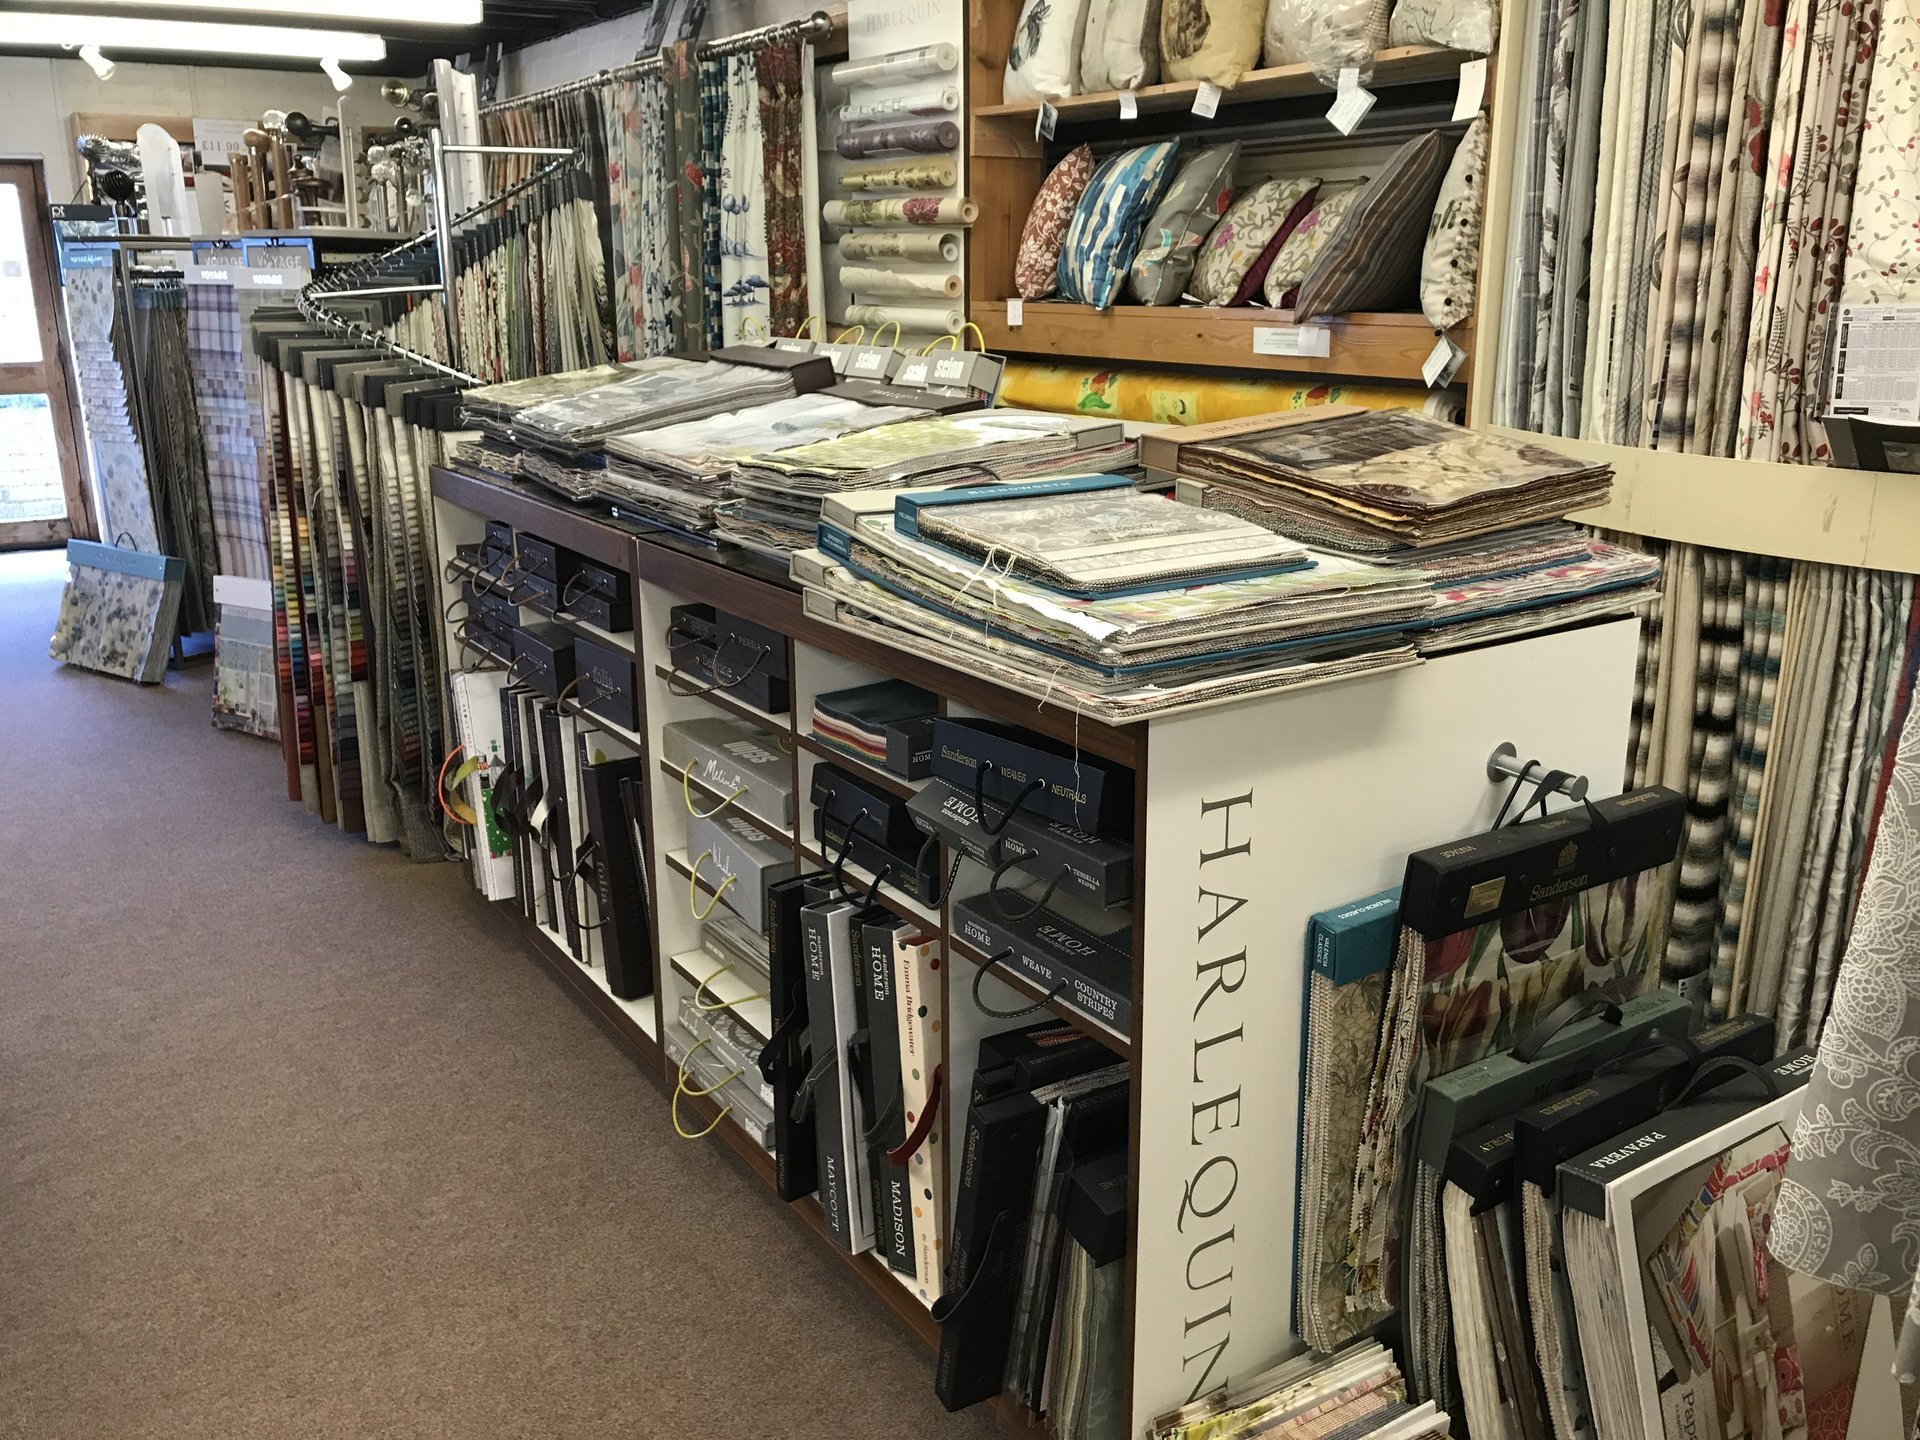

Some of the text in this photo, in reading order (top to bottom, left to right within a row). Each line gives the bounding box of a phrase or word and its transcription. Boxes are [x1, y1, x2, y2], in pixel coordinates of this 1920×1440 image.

[866, 1, 943, 32] HARLEQUIN
[202, 140, 240, 151] £11.99
[257, 256, 302, 267] VOYAGE
[855, 350, 882, 370] scion
[934, 357, 965, 379] scion
[738, 635, 762, 652] PERSIA
[912, 754, 931, 763] HOM
[941, 744, 1087, 804] Sanderson WEAVES NEUTRALS
[941, 808, 970, 825] sanderson
[1072, 868, 1100, 887] TESSELLA
[1077, 878, 1096, 891] WEAVES
[1530, 873, 1588, 901] Sanderson
[769, 898, 778, 953] Sanderson
[1038, 925, 1098, 957] HOME
[807, 927, 821, 982] HOME
[817, 935, 825, 976] sanderson
[851, 928, 862, 987] Sanderson
[964, 924, 1052, 980] HOME WEAVE
[1316, 933, 1324, 963] CLASSICS
[1322, 937, 1330, 967] VALENCIA
[871, 945, 885, 1001] HOME
[881, 954, 890, 995] sanderson
[903, 960, 916, 1057] Emma Bridgewater
[1074, 979, 1118, 1010] COUNTRY
[1076, 991, 1115, 1020] STRIPES
[1773, 1054, 1817, 1076] HOME
[1177, 787, 1253, 1405] HARLEQUIN
[1539, 1088, 1599, 1116] Sanderson
[964, 1124, 980, 1188] Sanderson
[1589, 1131, 1667, 1169] PAPAVERA
[827, 1155, 840, 1232] MAYCOTT
[891, 1180, 906, 1257] MADISON
